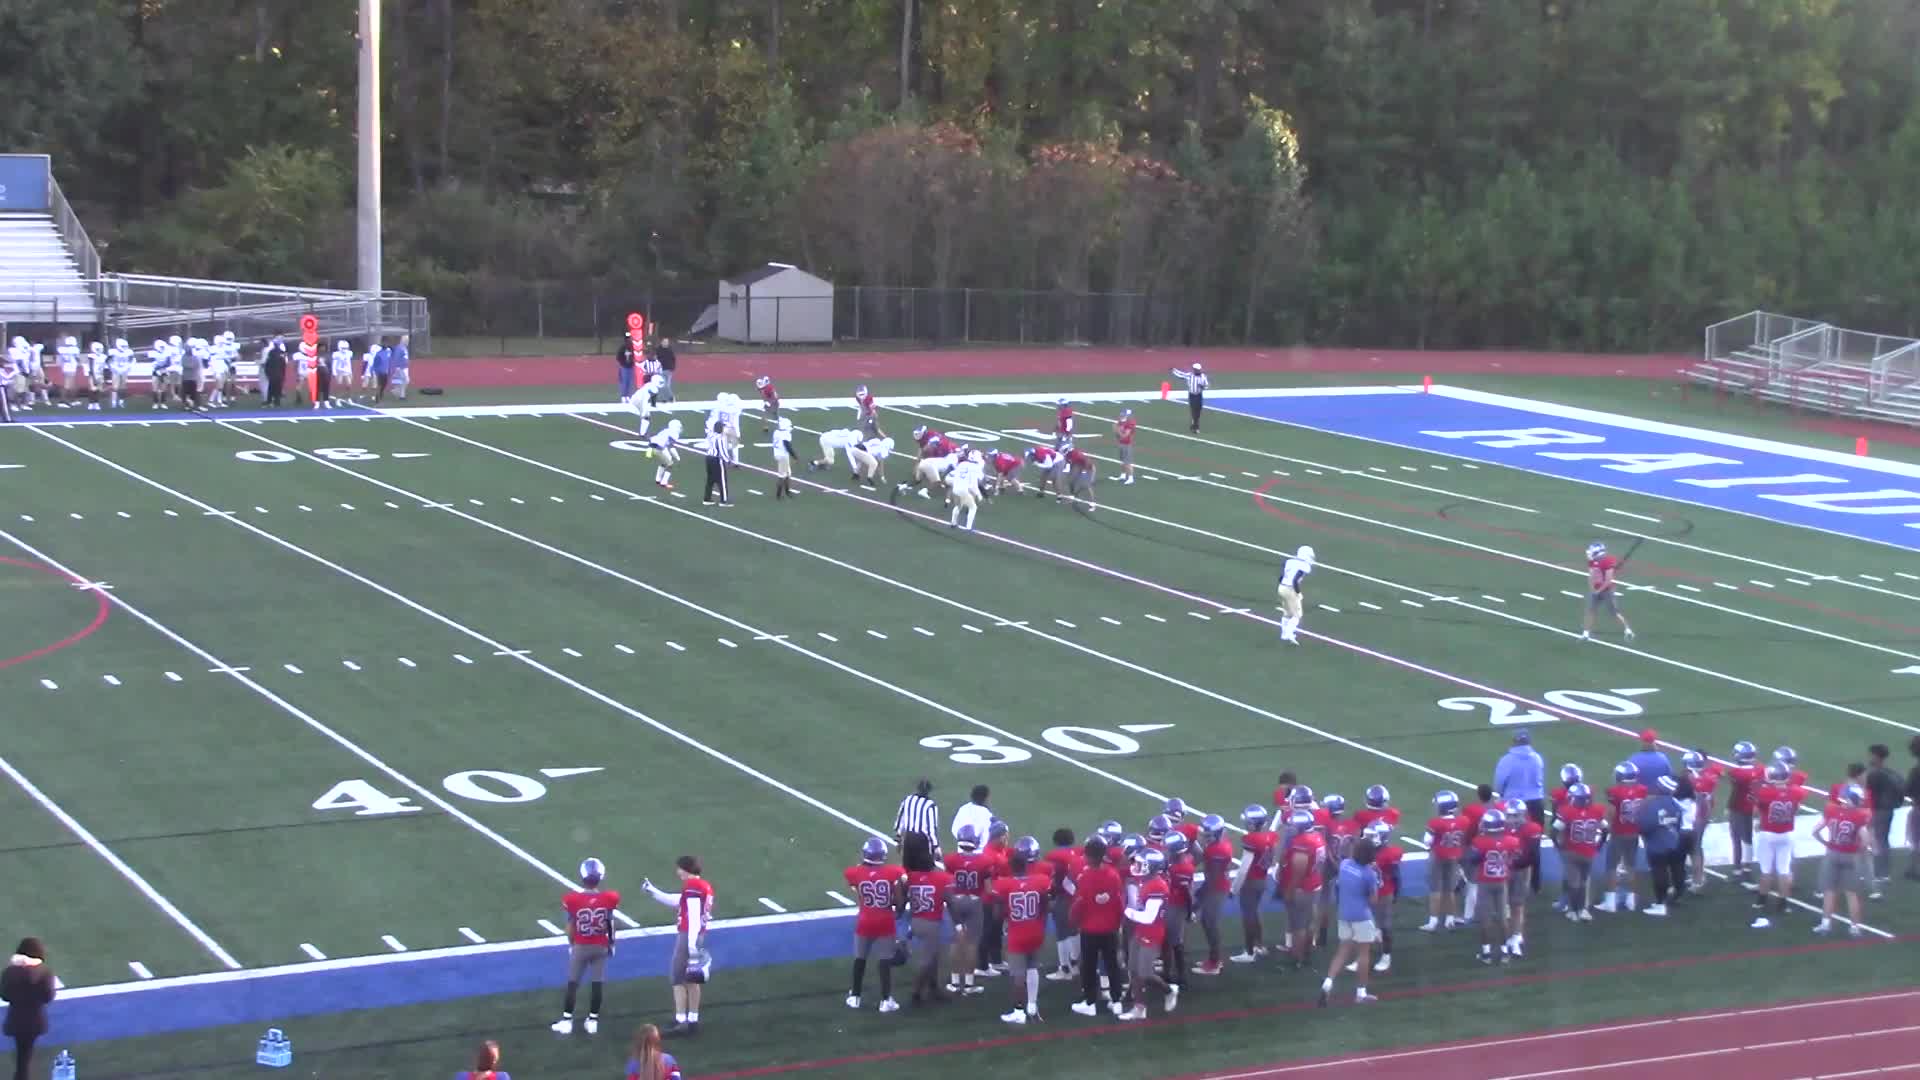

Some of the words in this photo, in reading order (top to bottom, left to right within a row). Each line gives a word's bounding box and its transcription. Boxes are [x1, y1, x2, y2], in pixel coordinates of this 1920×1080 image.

[1437, 688, 1644, 726] 20
[919, 724, 1142, 766] 30
[312, 768, 547, 815] 40
[575, 907, 609, 936] 23
[1008, 890, 1040, 922] 50
